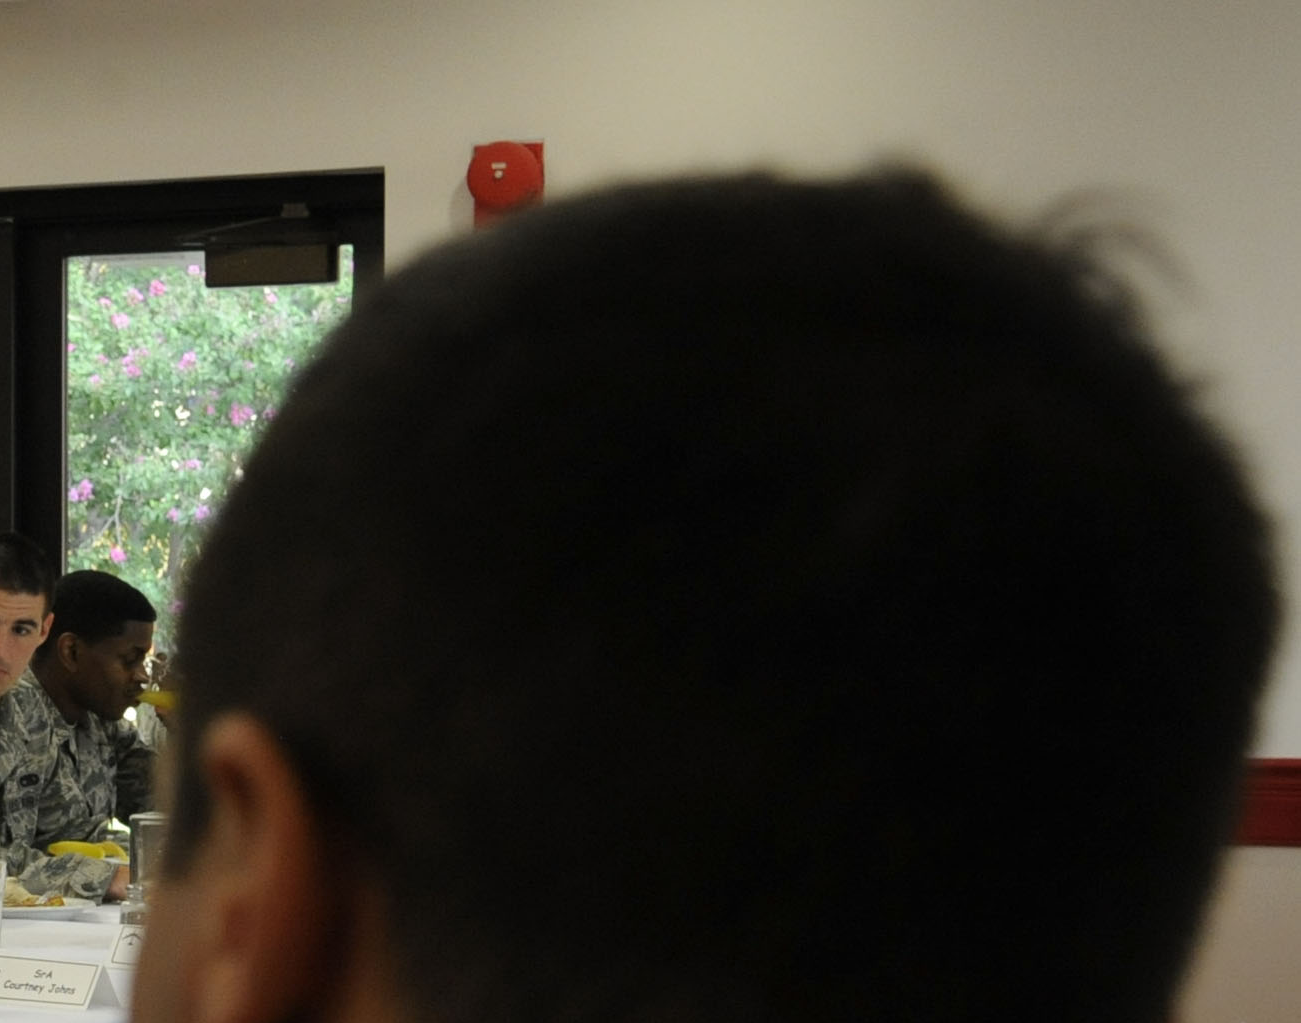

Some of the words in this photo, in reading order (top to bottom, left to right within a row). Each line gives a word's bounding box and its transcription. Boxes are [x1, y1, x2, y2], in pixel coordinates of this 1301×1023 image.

[33, 968, 53, 979] SrA
[3, 979, 45, 995] Courtney
[48, 982, 76, 996] Johns
